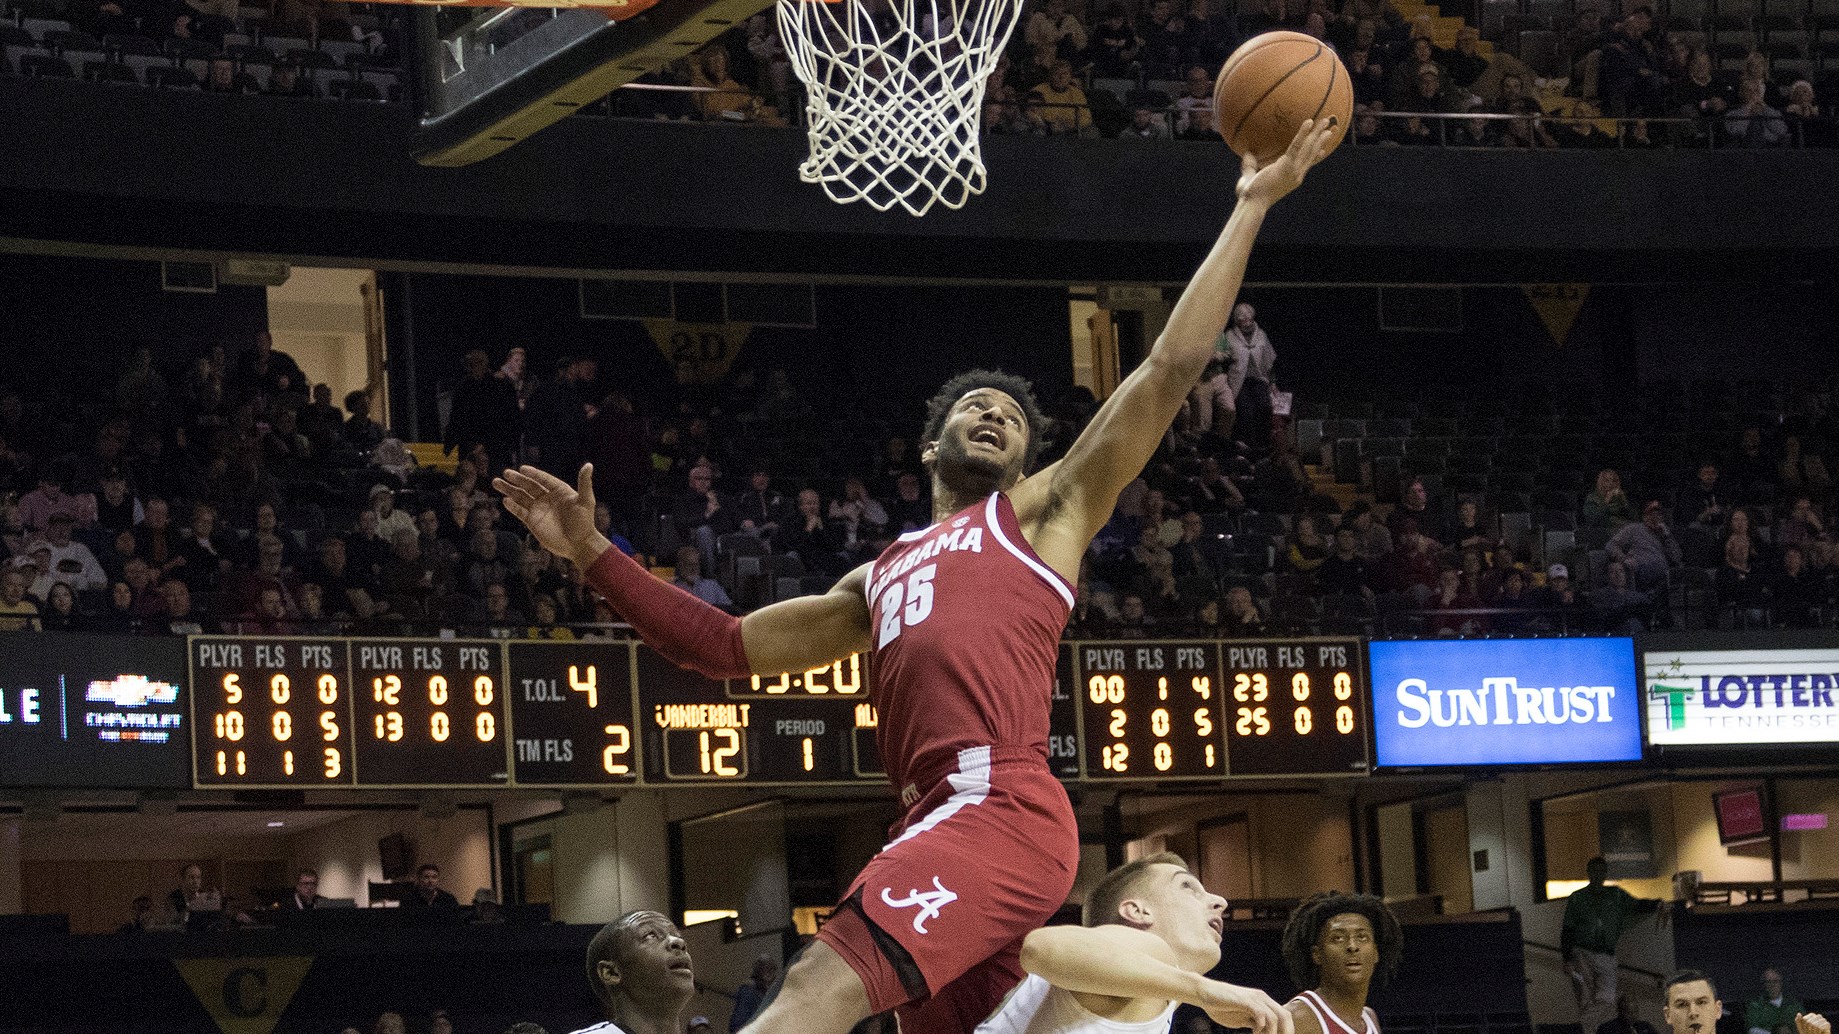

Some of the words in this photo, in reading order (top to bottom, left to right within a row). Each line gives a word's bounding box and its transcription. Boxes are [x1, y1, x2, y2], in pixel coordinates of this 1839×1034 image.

[879, 563, 937, 650] 25
[200, 645, 243, 668] PLYR
[256, 645, 285, 668] FLS
[302, 645, 333, 668] PTS
[361, 647, 402, 669] PLYR
[413, 647, 442, 669] FLS
[460, 647, 489, 670] PTS
[1086, 649, 1125, 670] PLYR
[1136, 649, 1164, 670] FLS
[1177, 649, 1206, 670] PTS
[1230, 648, 1268, 669] PLYR
[1278, 647, 1305, 668] FLS
[1319, 647, 1347, 668] PTS
[222, 673, 242, 704] 5
[271, 674, 290, 704] 0
[318, 674, 337, 704] 0
[373, 675, 401, 705] 12
[429, 676, 447, 705] 0
[474, 676, 493, 705] 0
[522, 680, 566, 701] T.O.L.
[569, 666, 597, 708] 4
[1089, 675, 1125, 703] 00
[1159, 677, 1167, 700] 1
[1192, 677, 1210, 699] 4
[1234, 673, 1268, 701] 23
[1292, 673, 1309, 701] 0
[1334, 672, 1351, 700] 0
[215, 711, 244, 741] 10
[272, 711, 291, 741] 0
[320, 711, 339, 741] 5
[375, 712, 403, 741] 13
[431, 712, 449, 741] 0
[476, 712, 495, 741] 0
[656, 704, 750, 727] VANDERBILT
[776, 720, 826, 735] PERIOD
[1110, 709, 1126, 737] 2
[1152, 708, 1170, 737] 0
[1194, 708, 1212, 736] 5
[1236, 707, 1270, 735] 25
[1294, 706, 1312, 734] 0
[1336, 706, 1353, 734] 0
[517, 740, 541, 760] TM
[545, 740, 573, 761] FLS
[604, 725, 630, 776] 2
[699, 726, 740, 776] 12
[803, 738, 813, 771] 1
[1049, 735, 1076, 757] FLS
[1103, 743, 1128, 771] 12
[1154, 742, 1172, 771] 0
[1205, 745, 1214, 767] 1
[217, 751, 246, 775] 11
[284, 751, 293, 775] 1
[325, 748, 340, 777] 3
[881, 876, 958, 934] A
[223, 968, 268, 1018] C
